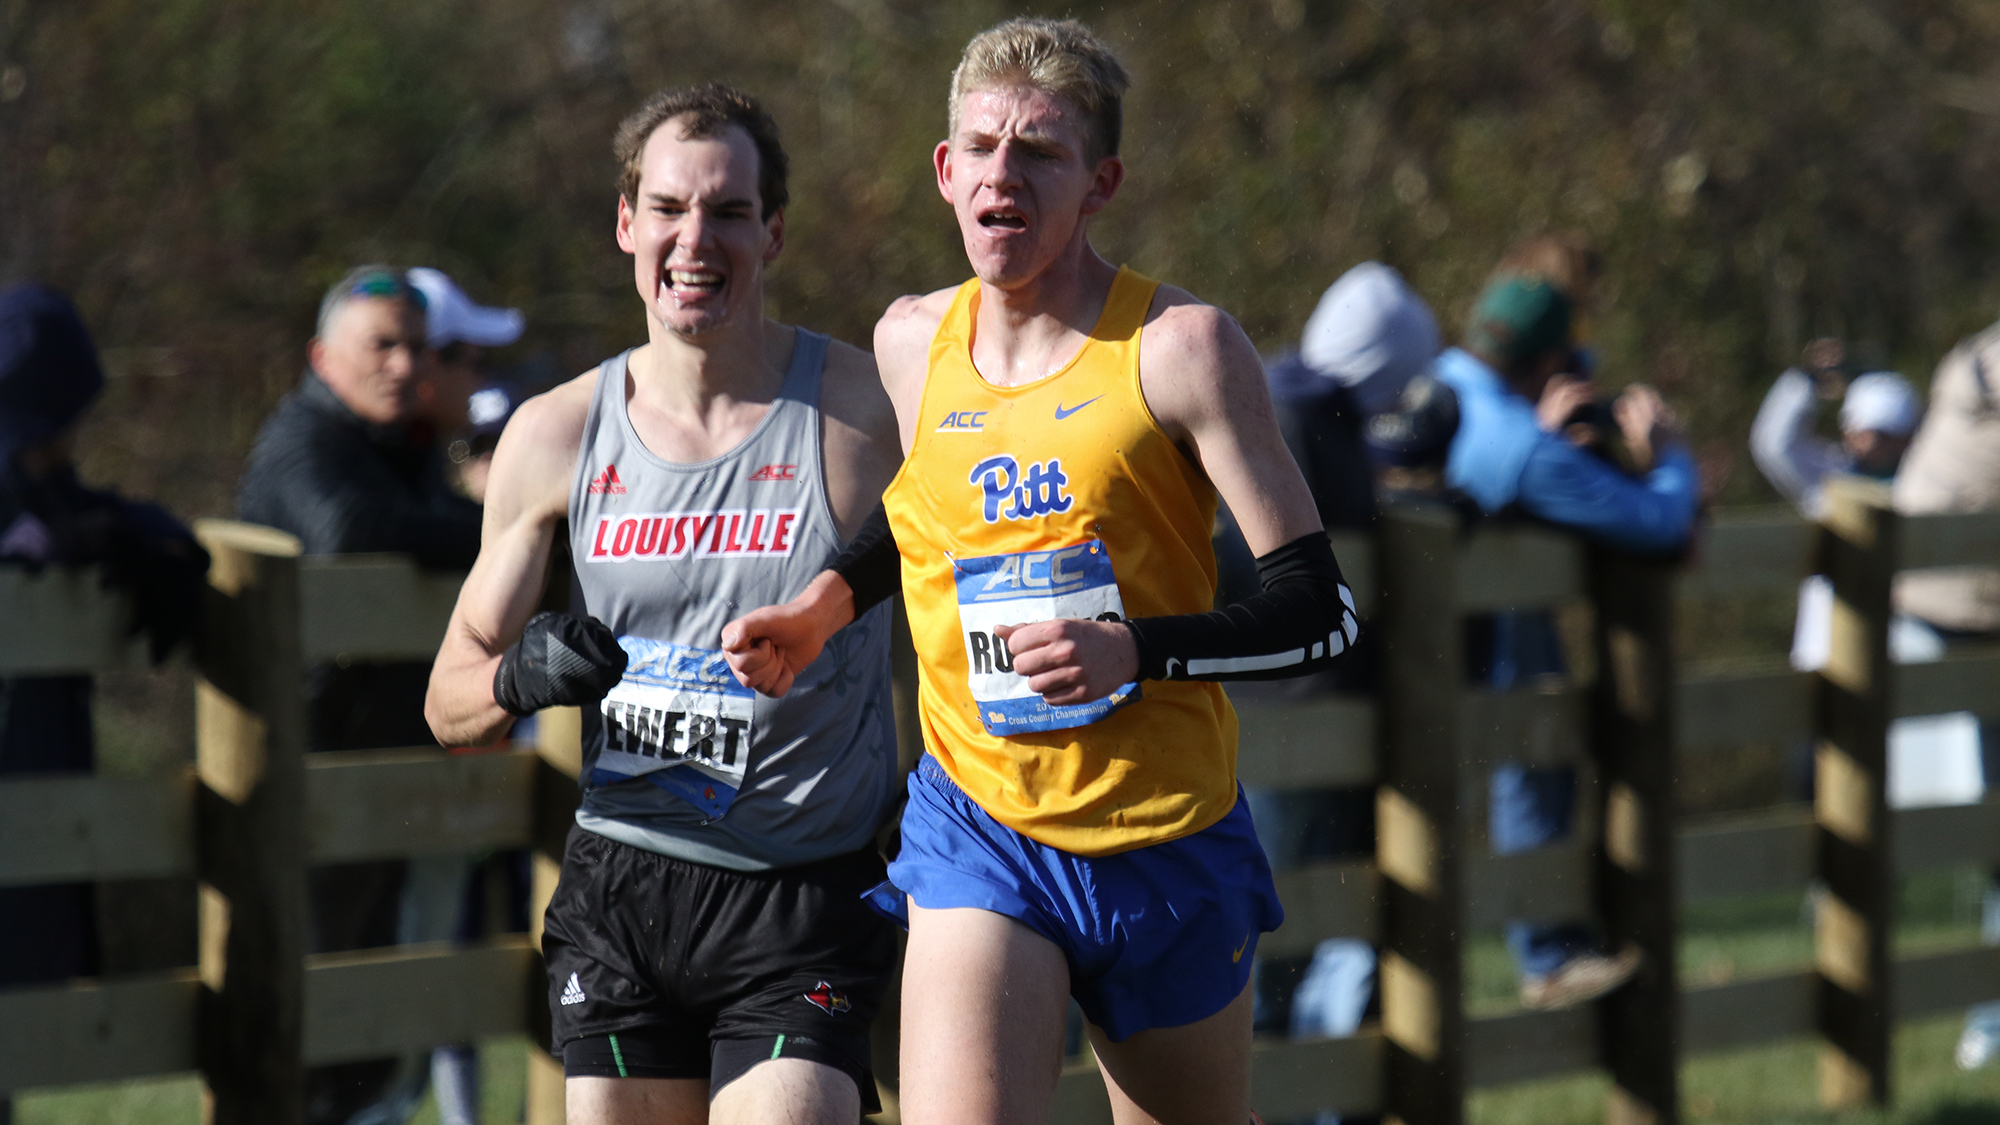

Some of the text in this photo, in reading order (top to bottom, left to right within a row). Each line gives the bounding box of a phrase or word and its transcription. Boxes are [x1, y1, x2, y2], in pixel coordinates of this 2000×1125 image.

[938, 411, 988, 428] ACC
[751, 464, 798, 479] ACC
[969, 454, 1074, 524] Pitt
[588, 509, 799, 561] LOUISVILLE
[982, 547, 1085, 590] ACC
[626, 646, 730, 683] ACC
[606, 700, 749, 766] EWERT
[1008, 716, 1028, 726] Cross
[1028, 713, 1054, 723] Country
[1055, 704, 1109, 720] Championships
[560, 991, 586, 1006] adidas
